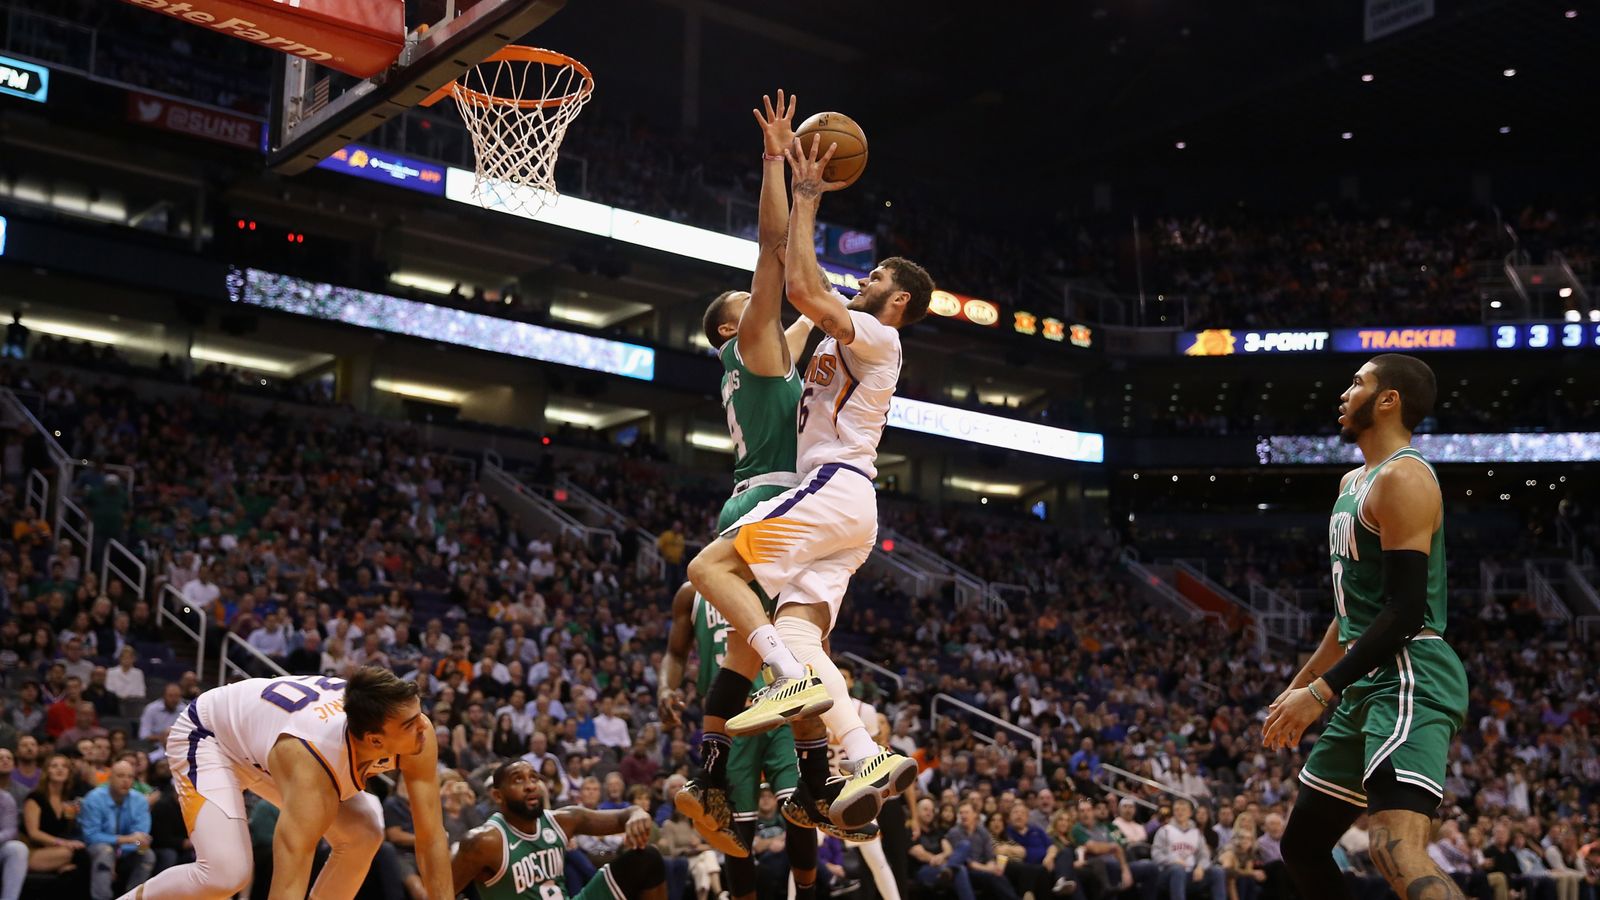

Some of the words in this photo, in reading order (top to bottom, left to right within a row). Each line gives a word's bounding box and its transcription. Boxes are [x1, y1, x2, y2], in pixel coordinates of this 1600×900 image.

[210, 17, 333, 61] Farm
[165, 105, 252, 144] @SUNS
[1244, 332, 1329, 352] 3-POINT
[1358, 329, 1457, 349] TRACKER
[1496, 325, 1517, 349] 3
[1528, 324, 1550, 348] 3
[1562, 324, 1583, 347] 3
[512, 847, 564, 894] BOSTON
